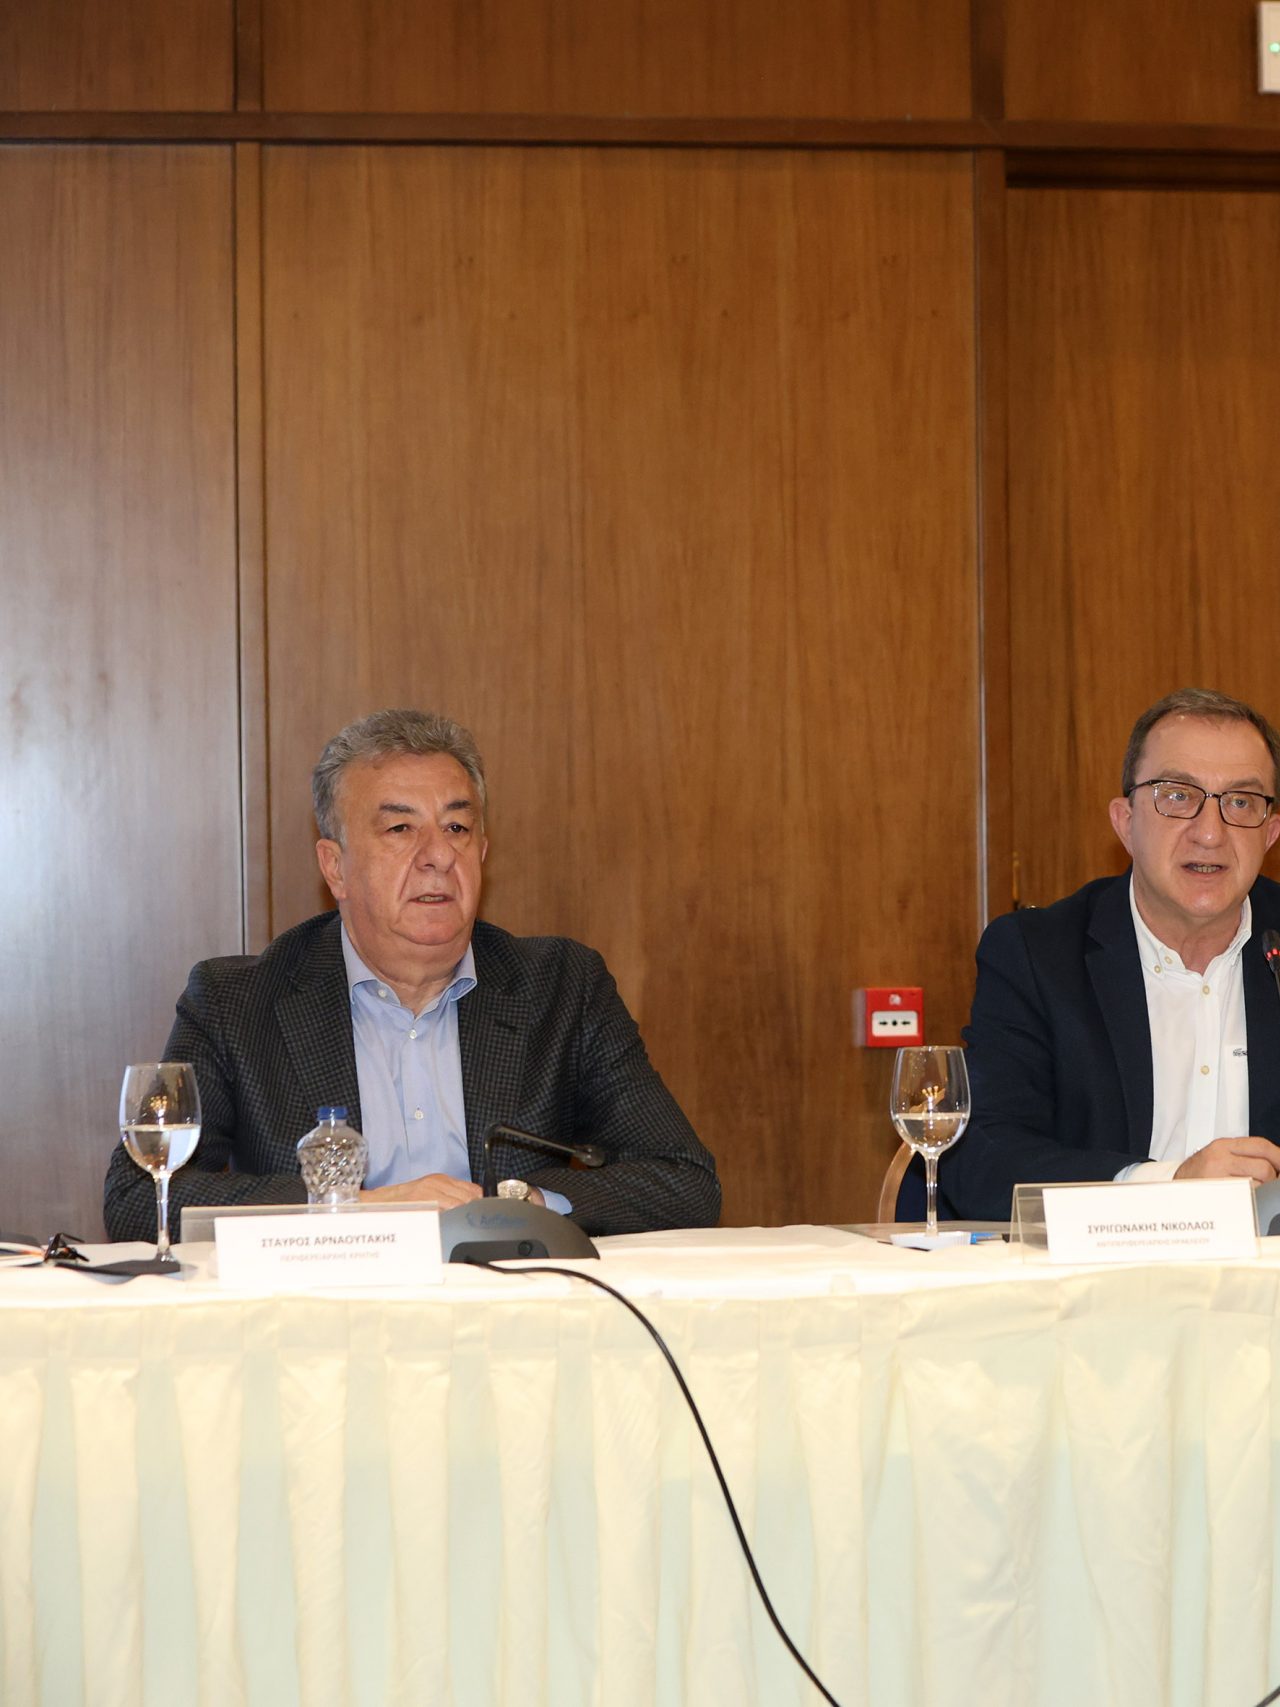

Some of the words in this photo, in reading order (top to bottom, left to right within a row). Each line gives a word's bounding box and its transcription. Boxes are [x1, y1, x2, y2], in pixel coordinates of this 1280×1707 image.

[1087, 1223, 1158, 1235] ΣΥΡΙΓΩΝΑΚΗΣ
[1161, 1220, 1215, 1232] ΝΙΚΟΛΑΟΣ
[261, 1237, 310, 1248] ΣΤΑΥΡΟΣ
[314, 1233, 397, 1245] ΑΡΝΑΟΥΤΑΚΗΣ
